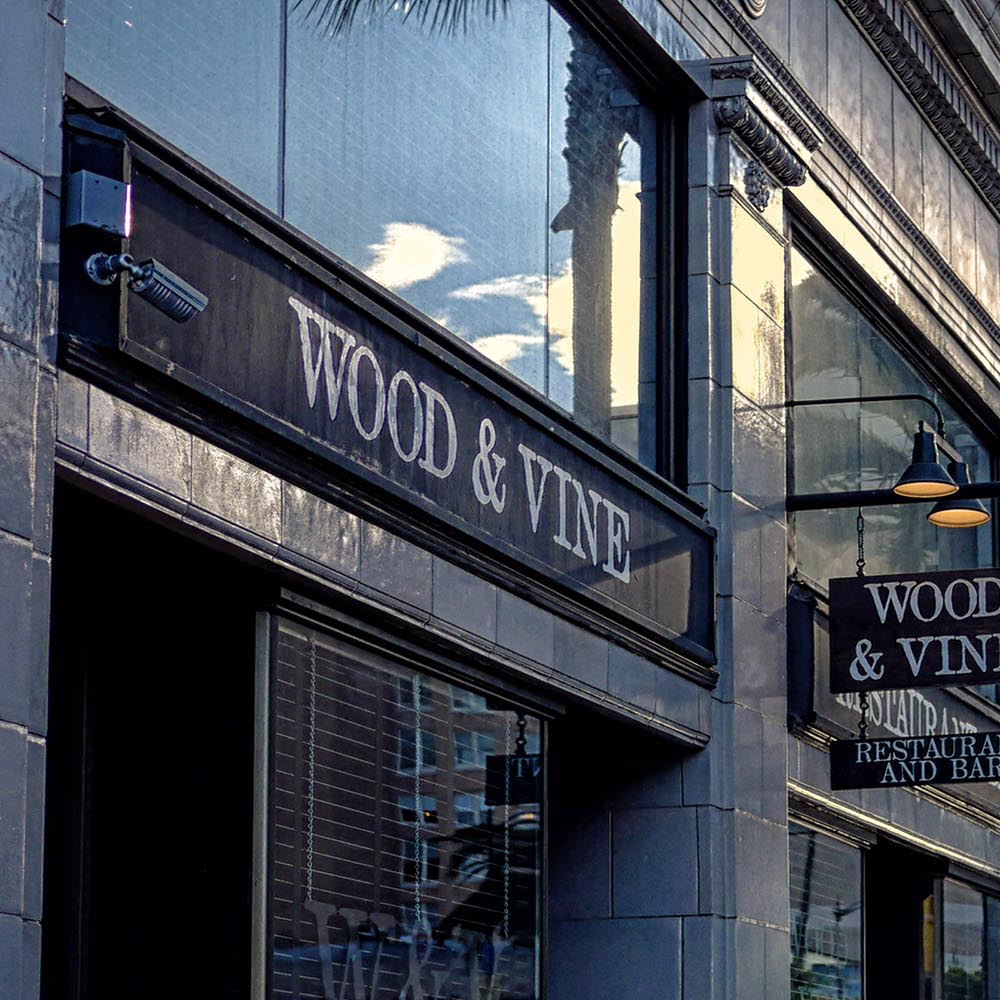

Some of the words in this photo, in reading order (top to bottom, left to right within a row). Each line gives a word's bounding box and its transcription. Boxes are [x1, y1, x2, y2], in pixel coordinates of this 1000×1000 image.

[288, 296, 457, 479] WOOD
[472, 417, 507, 513] &
[518, 443, 631, 584] VINE
[850, 638, 885, 682] &
[880, 760, 937, 785] AND
